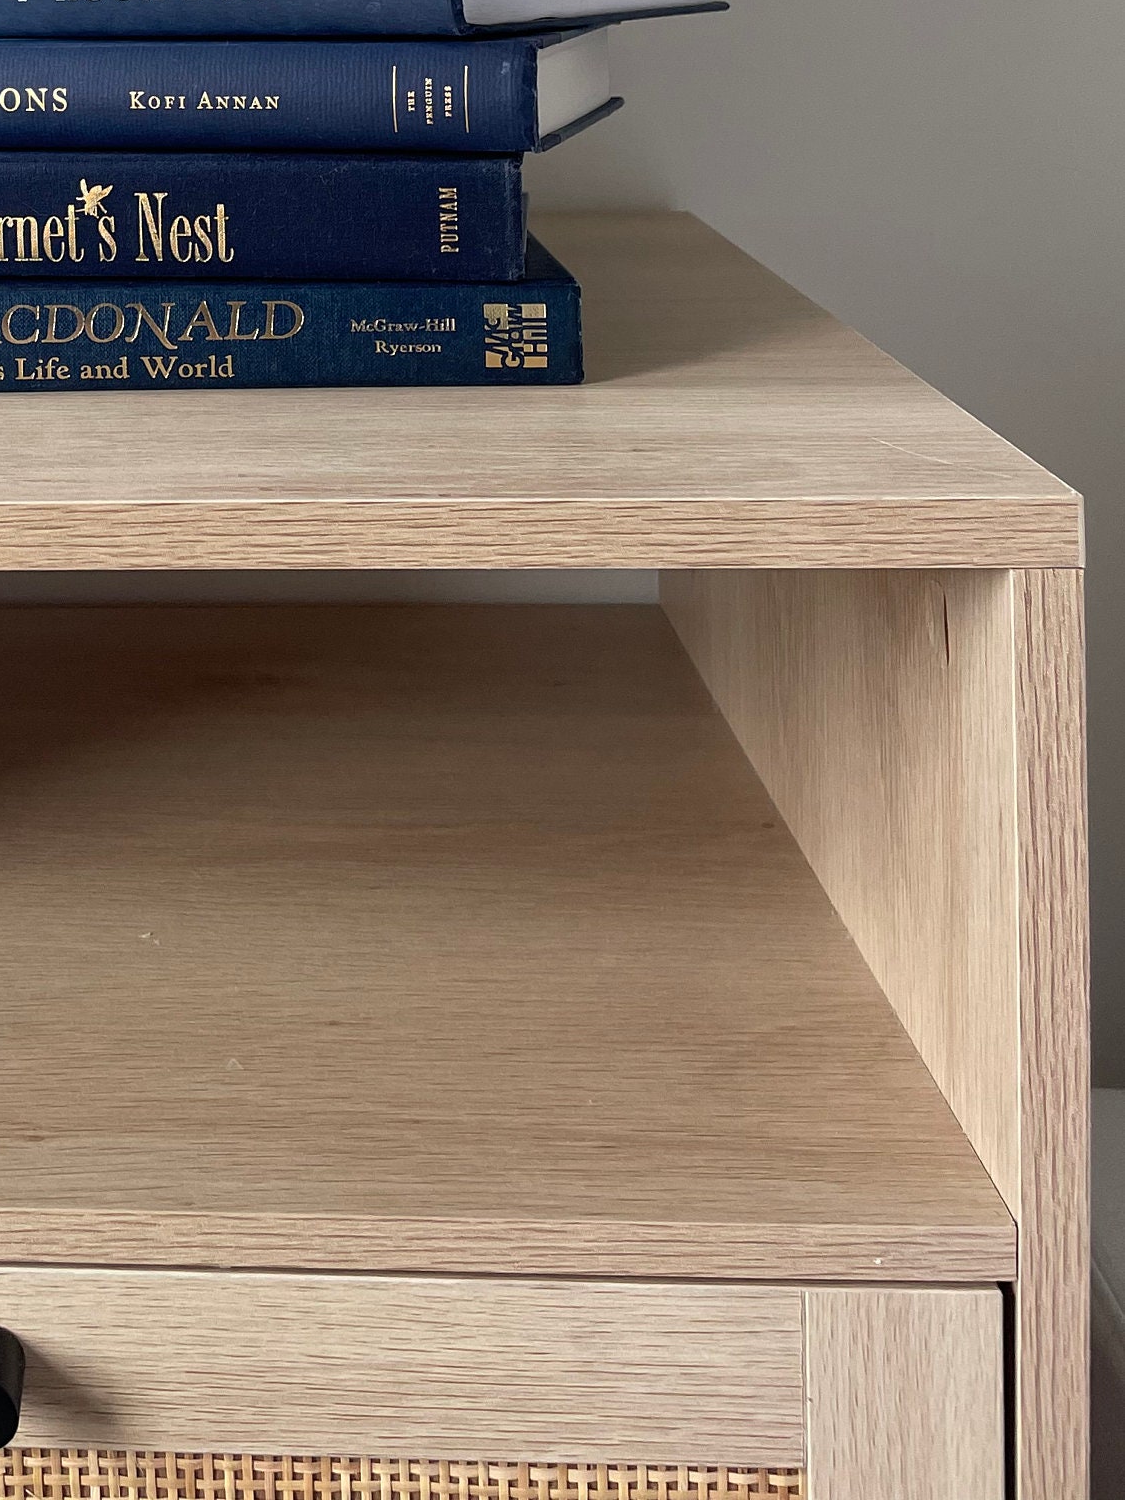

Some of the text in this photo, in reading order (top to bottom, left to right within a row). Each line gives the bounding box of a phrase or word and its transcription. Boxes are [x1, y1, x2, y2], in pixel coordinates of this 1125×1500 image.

[425, 78, 433, 124] PENGUIN
[134, 193, 234, 262] Nest
[439, 188, 459, 252] PUTNAM
[351, 318, 455, 332] McGraw-Hill
[375, 341, 441, 356] Ryerson
[15, 357, 69, 380] Life
[81, 356, 130, 379] and
[141, 355, 235, 379] World
